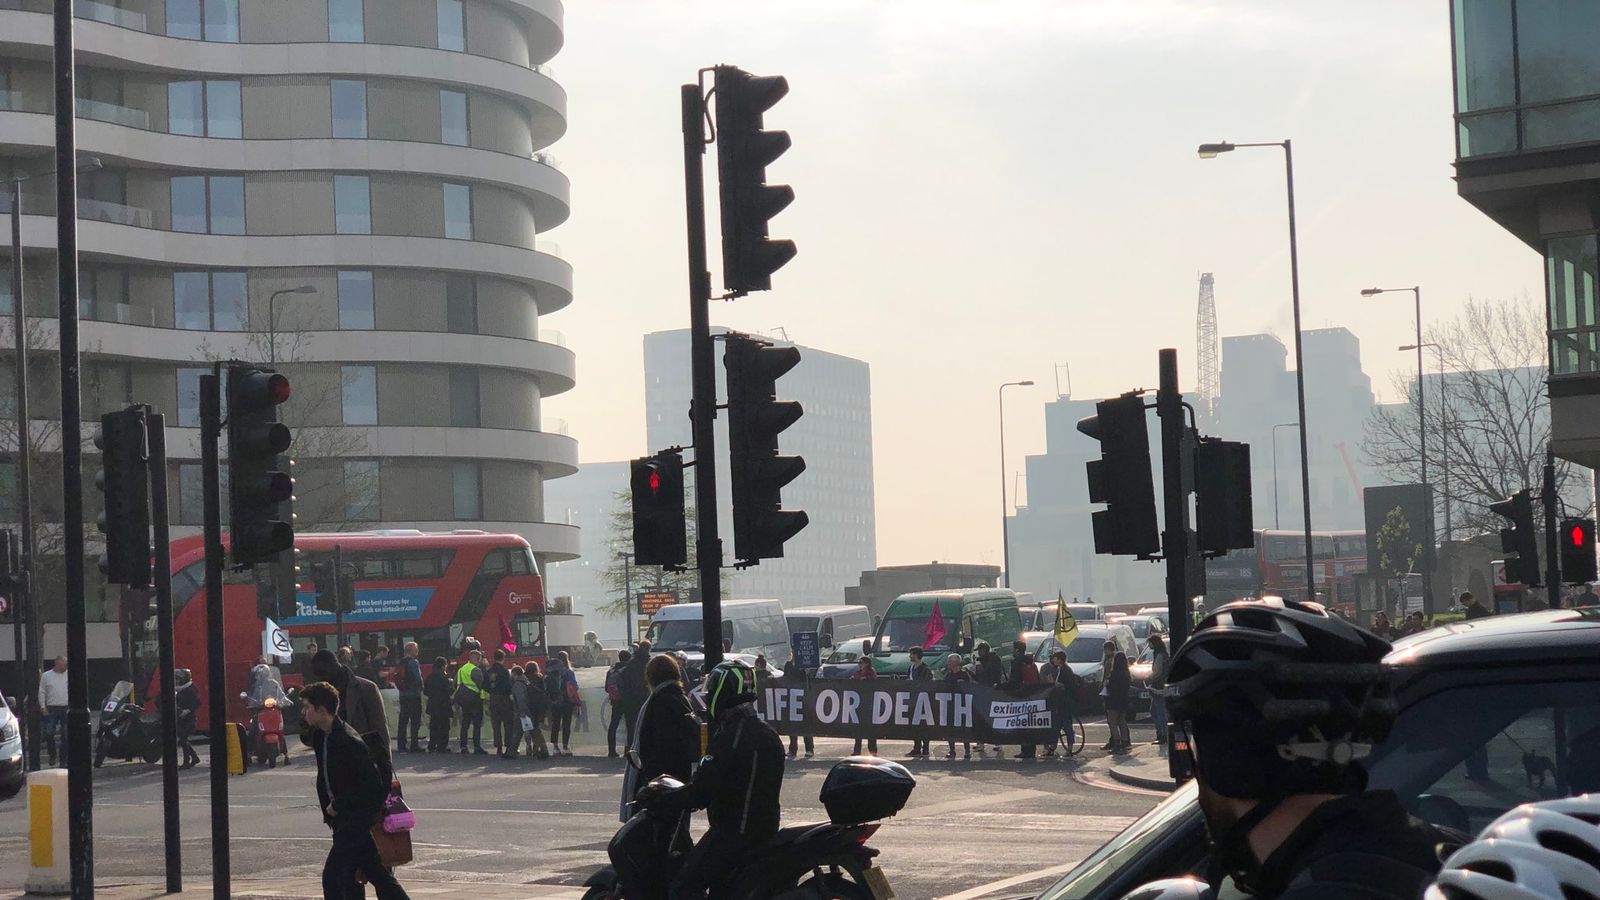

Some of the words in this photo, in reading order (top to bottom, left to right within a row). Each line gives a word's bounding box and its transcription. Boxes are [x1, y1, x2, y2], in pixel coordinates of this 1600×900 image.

[754, 688, 805, 722] IFE
[815, 689, 861, 725] OR
[871, 691, 974, 728] DEATH
[993, 703, 1038, 714] extinction
[1006, 713, 1050, 727] rebellion
